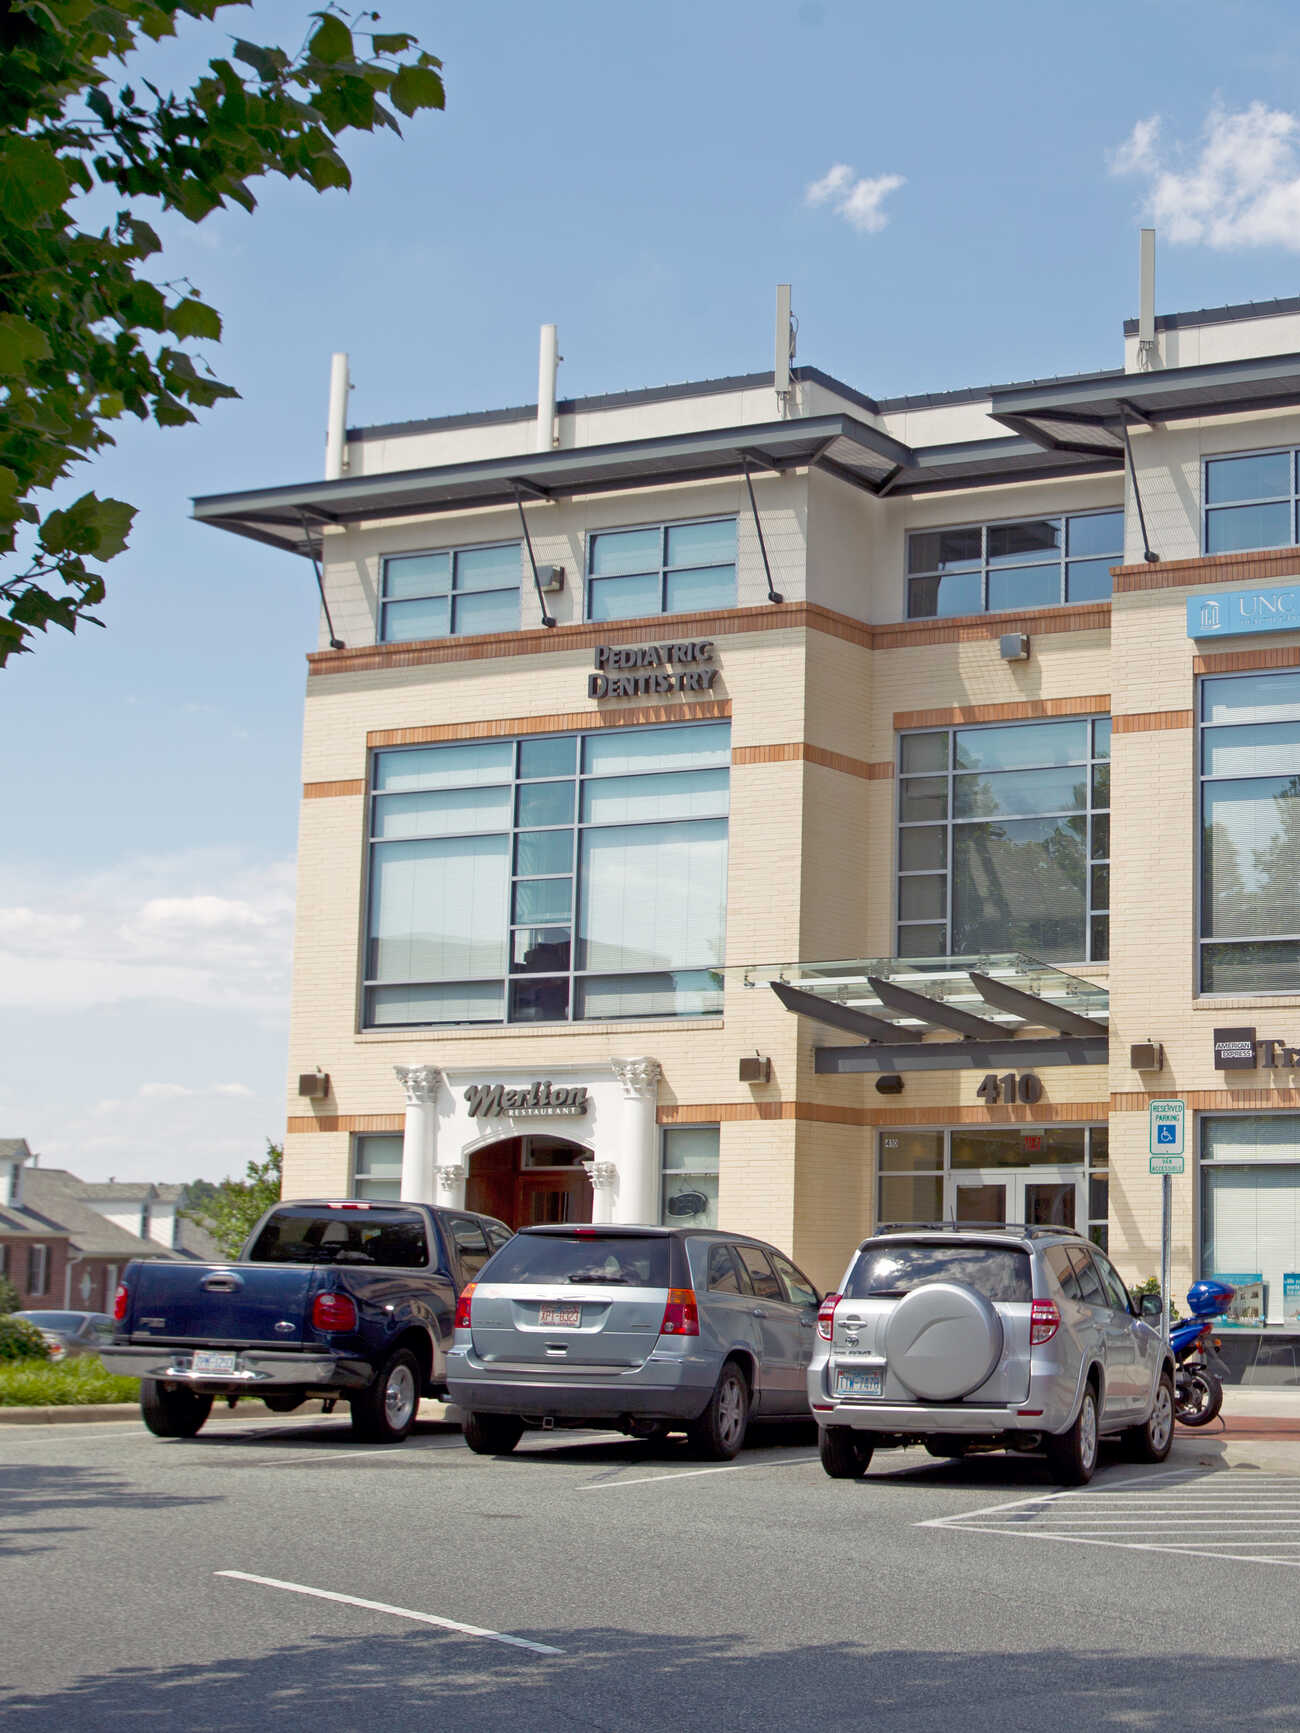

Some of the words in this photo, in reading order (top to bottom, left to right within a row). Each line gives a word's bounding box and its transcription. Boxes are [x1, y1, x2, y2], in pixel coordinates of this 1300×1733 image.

[1239, 592, 1296, 617] UNC
[594, 640, 714, 670] PEDIATRIC
[587, 667, 720, 699] DENTISTRY
[1215, 1041, 1251, 1051] AMERICAN
[1221, 1050, 1252, 1059] EXPRESS
[976, 1073, 1043, 1105] 410
[463, 1080, 589, 1118] Merlion
[508, 1107, 577, 1117] RESTAURANT
[1152, 1104, 1183, 1113] RESERVED
[1155, 1114, 1180, 1122] PARKING
